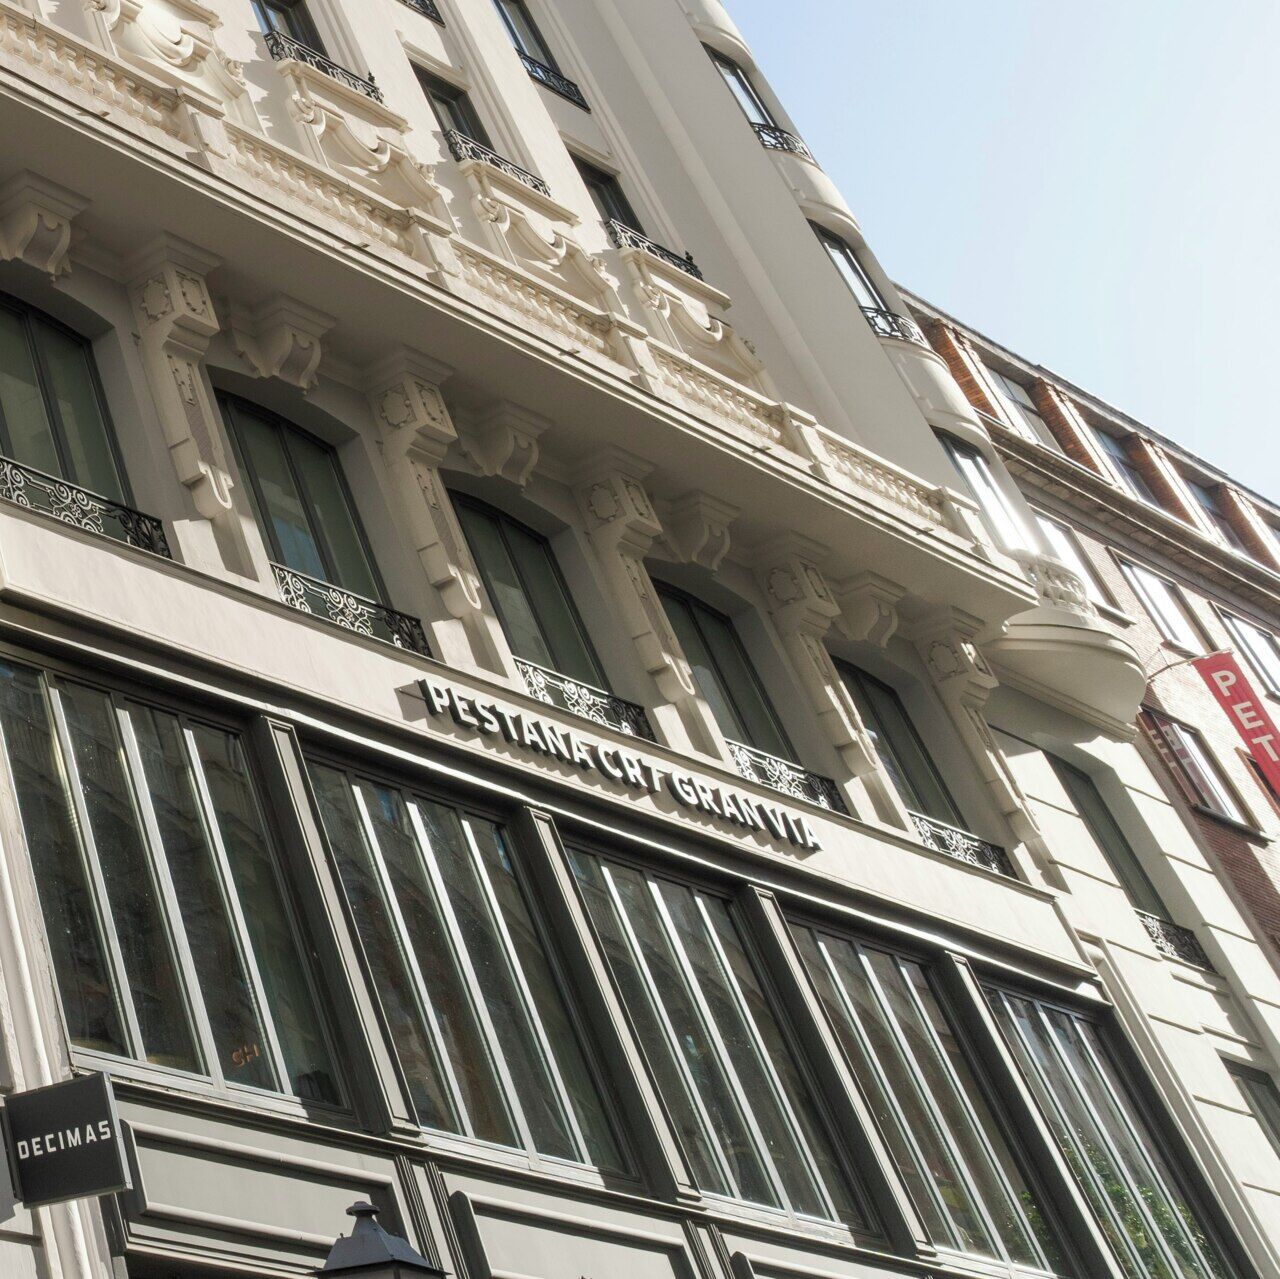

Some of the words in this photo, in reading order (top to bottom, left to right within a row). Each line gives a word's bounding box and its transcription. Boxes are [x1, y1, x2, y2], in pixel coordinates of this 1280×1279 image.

[419, 677, 595, 769] PESTANA
[668, 770, 766, 831] GRAN
[17, 1120, 112, 1160] DECIMAS
